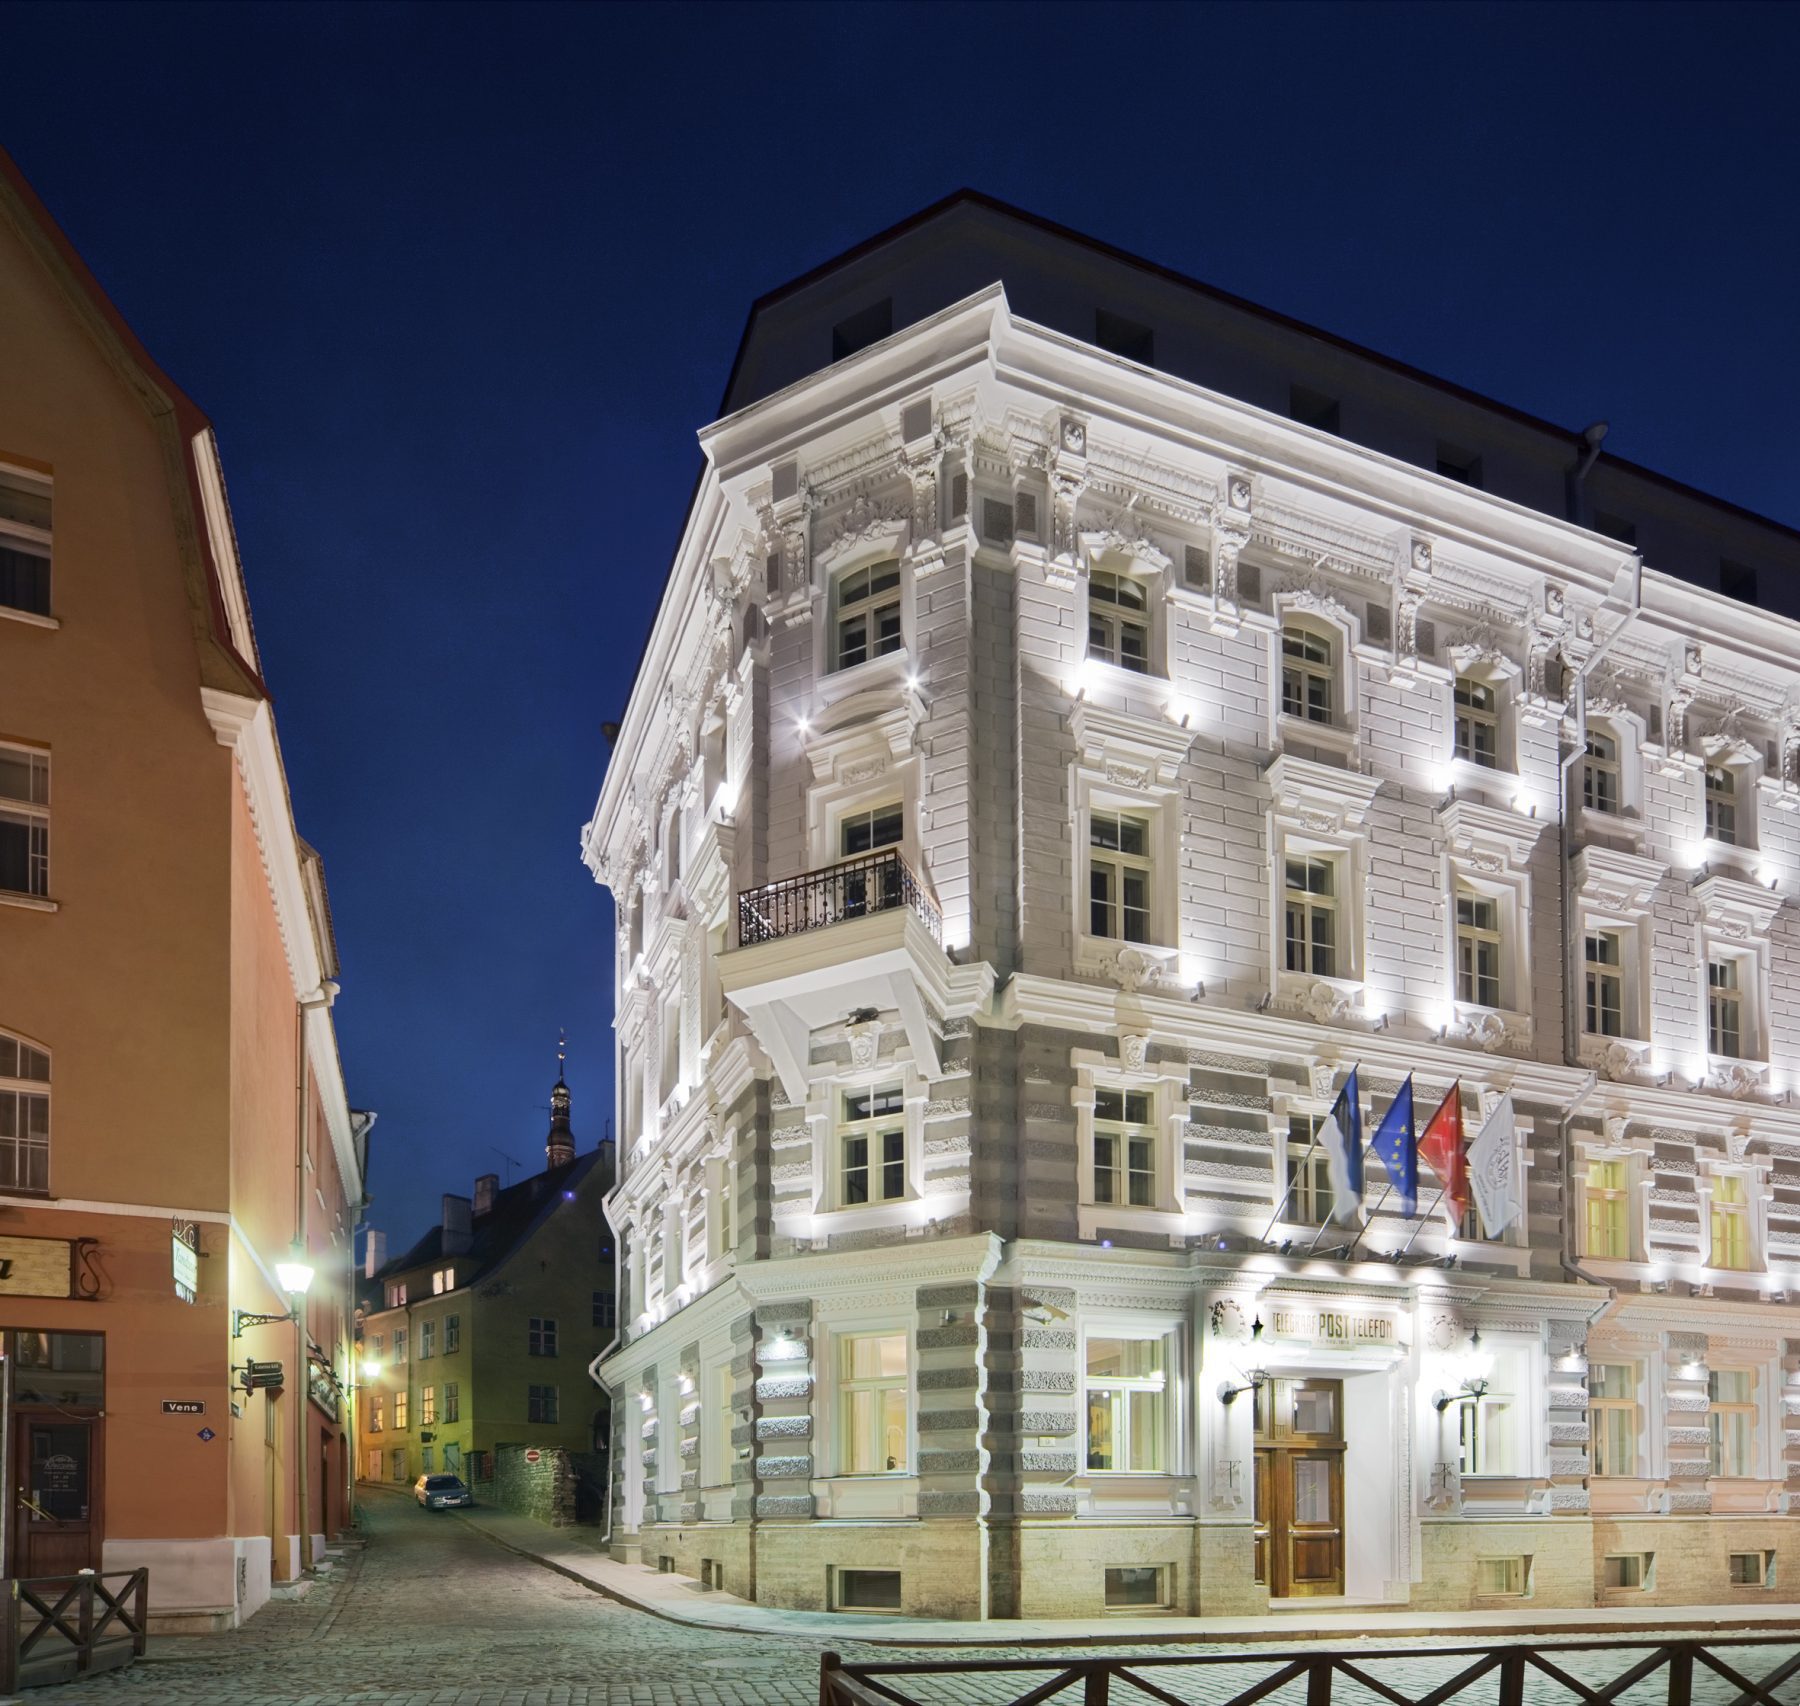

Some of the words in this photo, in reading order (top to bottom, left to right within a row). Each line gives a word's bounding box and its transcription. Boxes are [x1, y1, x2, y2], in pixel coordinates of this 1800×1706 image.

[1318, 1313, 1350, 1338] POST
[1353, 1317, 1392, 1338] TELEFON
[168, 1403, 198, 1412] Vene
